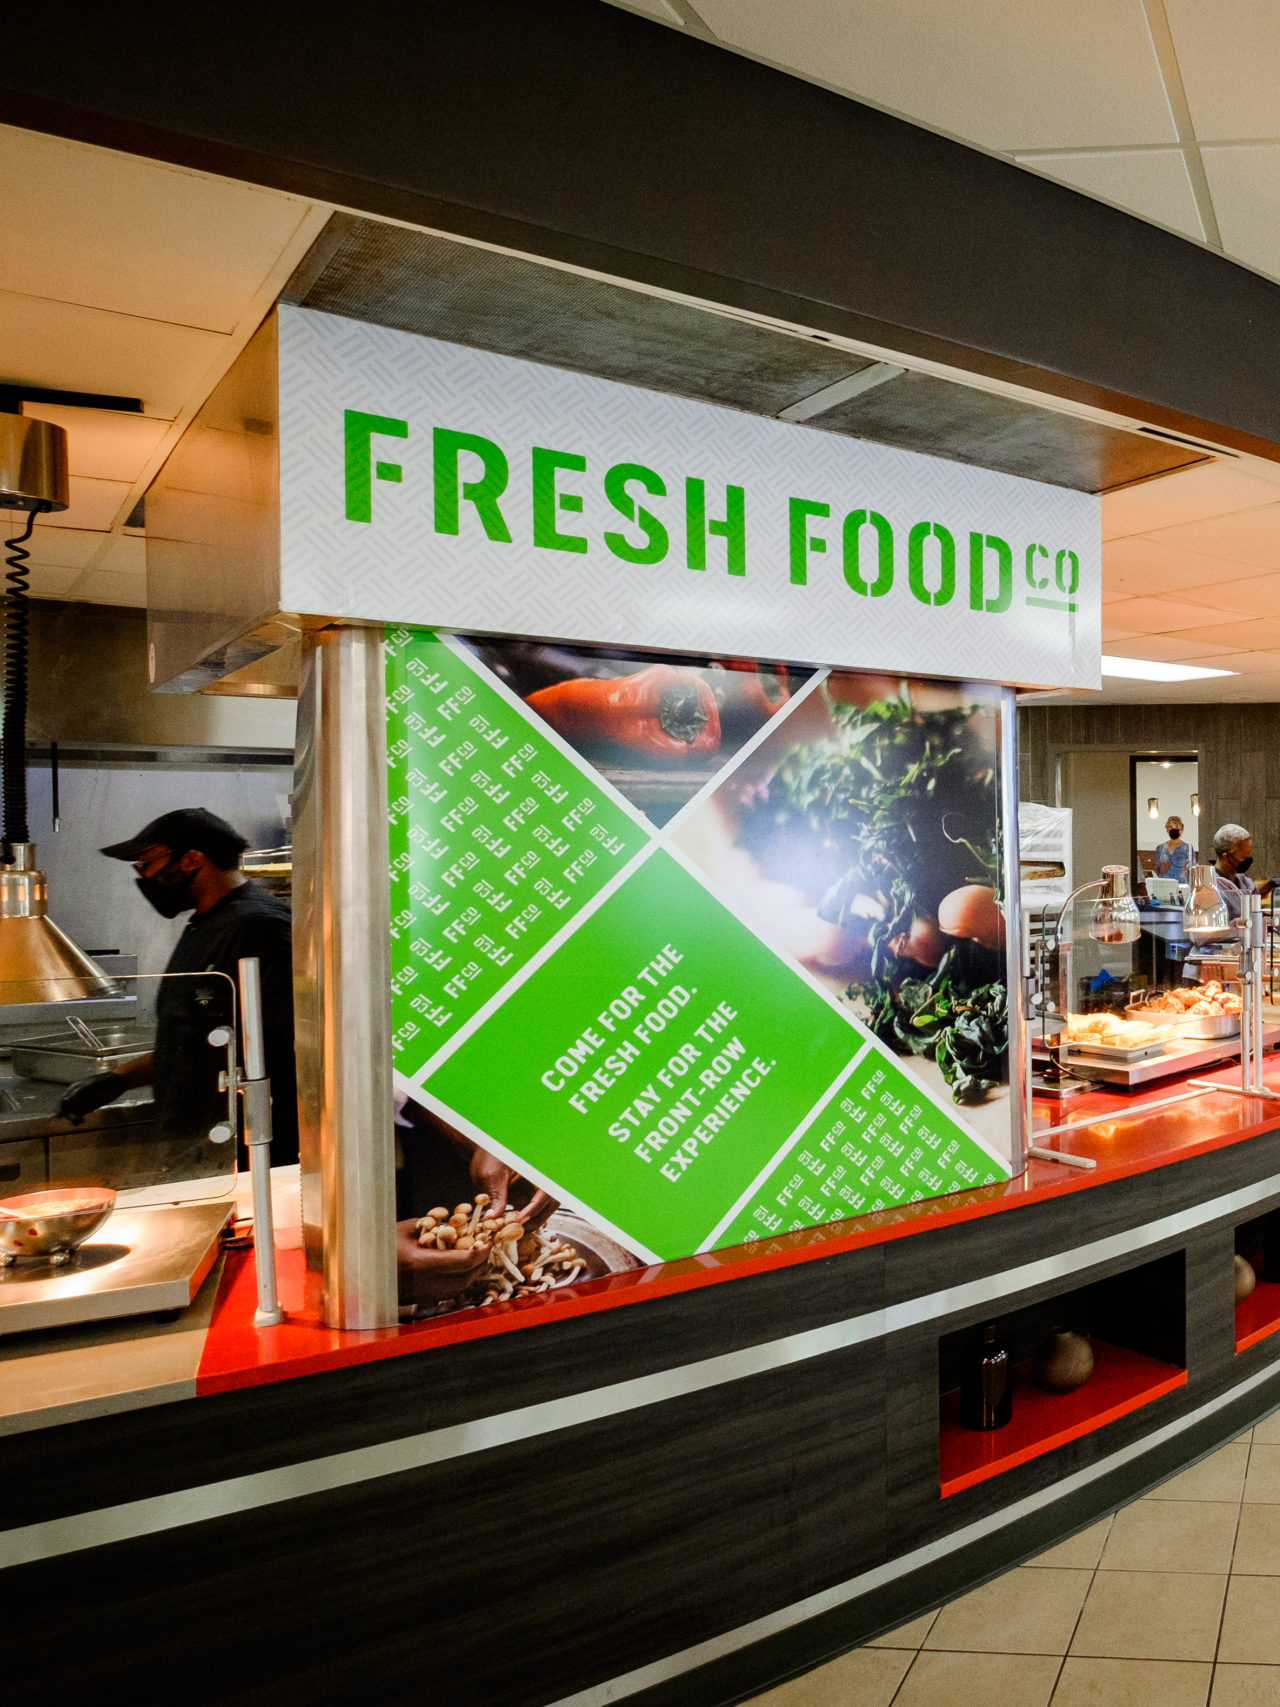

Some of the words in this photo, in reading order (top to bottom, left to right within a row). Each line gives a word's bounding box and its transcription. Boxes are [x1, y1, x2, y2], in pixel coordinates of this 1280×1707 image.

[343, 409, 746, 578] FRESH
[789, 498, 1013, 614] FOOD
[540, 1026, 605, 1092] COME
[597, 985, 645, 1032] FOR
[637, 943, 684, 988] THE
[568, 1040, 640, 1115] FRESH
[633, 985, 698, 1045] FOOD.
[608, 1083, 662, 1143] STAY
[656, 1043, 702, 1088] FOR
[694, 1000, 738, 1043] THE
[633, 1036, 747, 1164] FRONT-ROW
[659, 1057, 777, 1183] EXPERIENCE.
